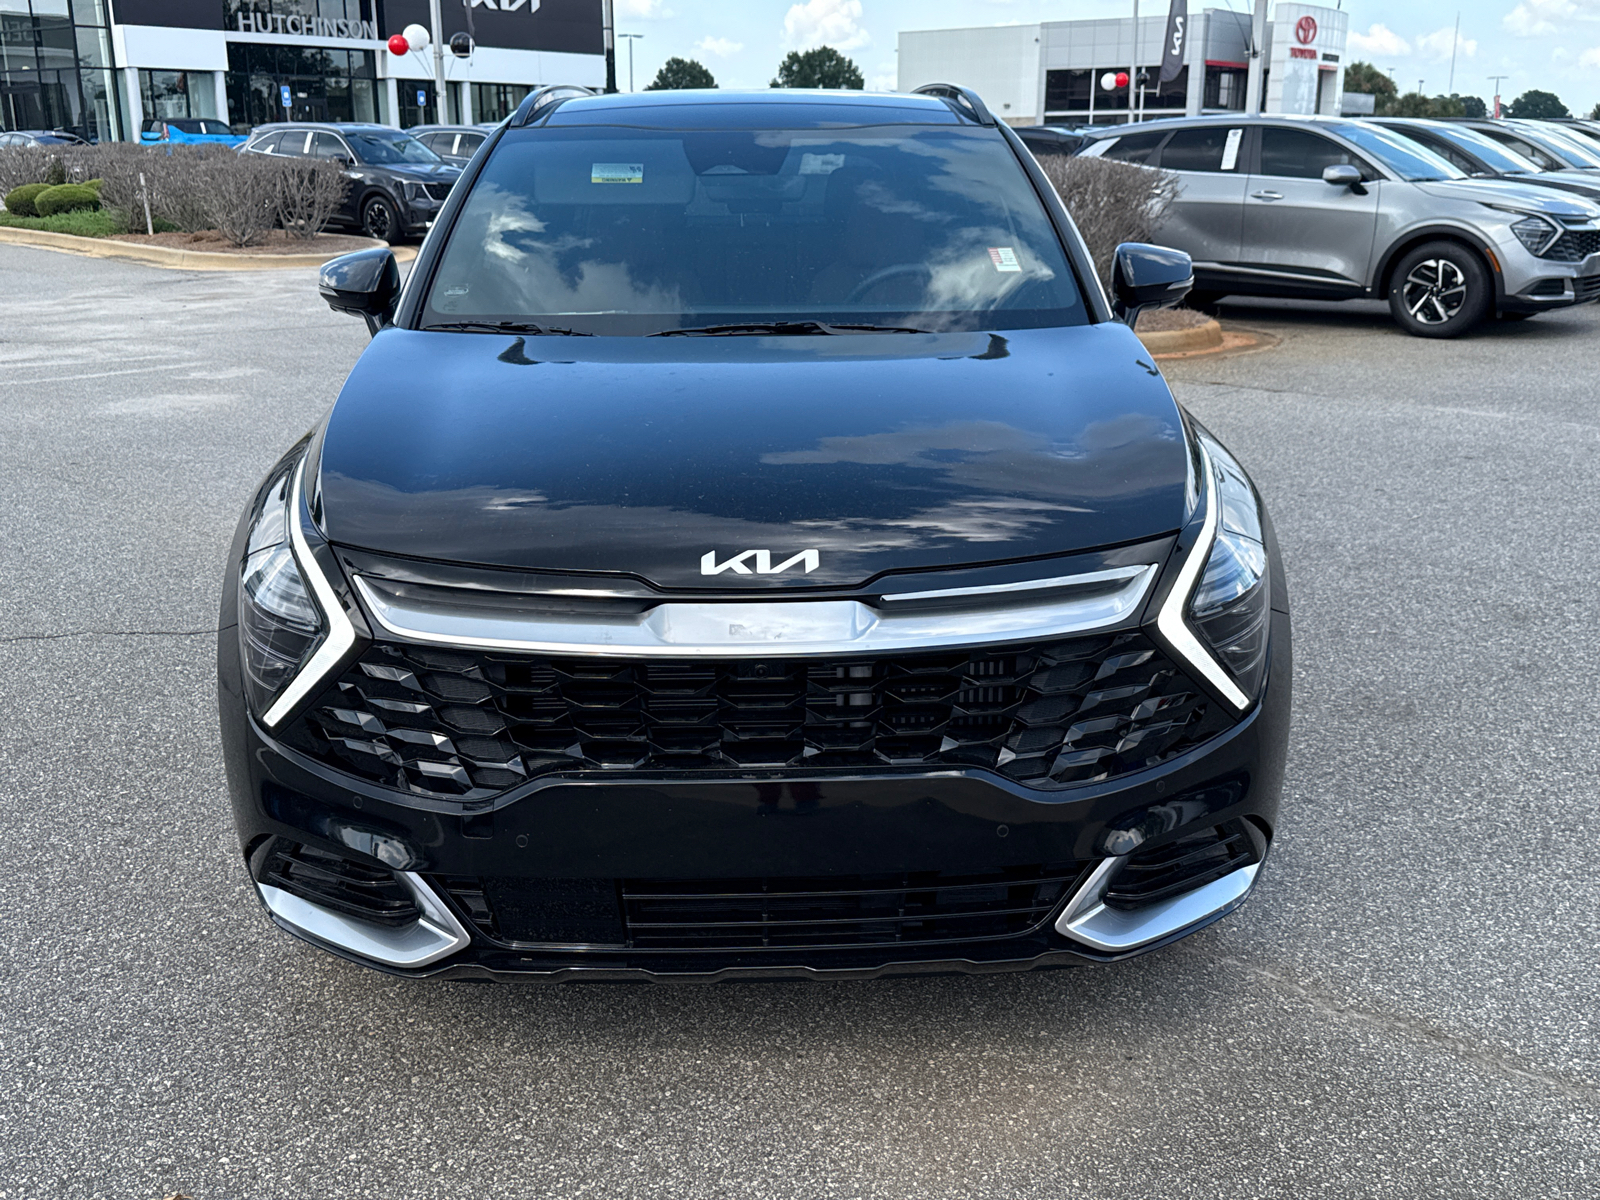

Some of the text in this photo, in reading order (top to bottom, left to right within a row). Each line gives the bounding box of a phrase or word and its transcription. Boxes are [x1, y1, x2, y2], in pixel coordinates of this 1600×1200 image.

[237, 11, 376, 40] HUTCHINSON
[1171, 16, 1184, 56] KIA
[700, 549, 820, 576] KIA
